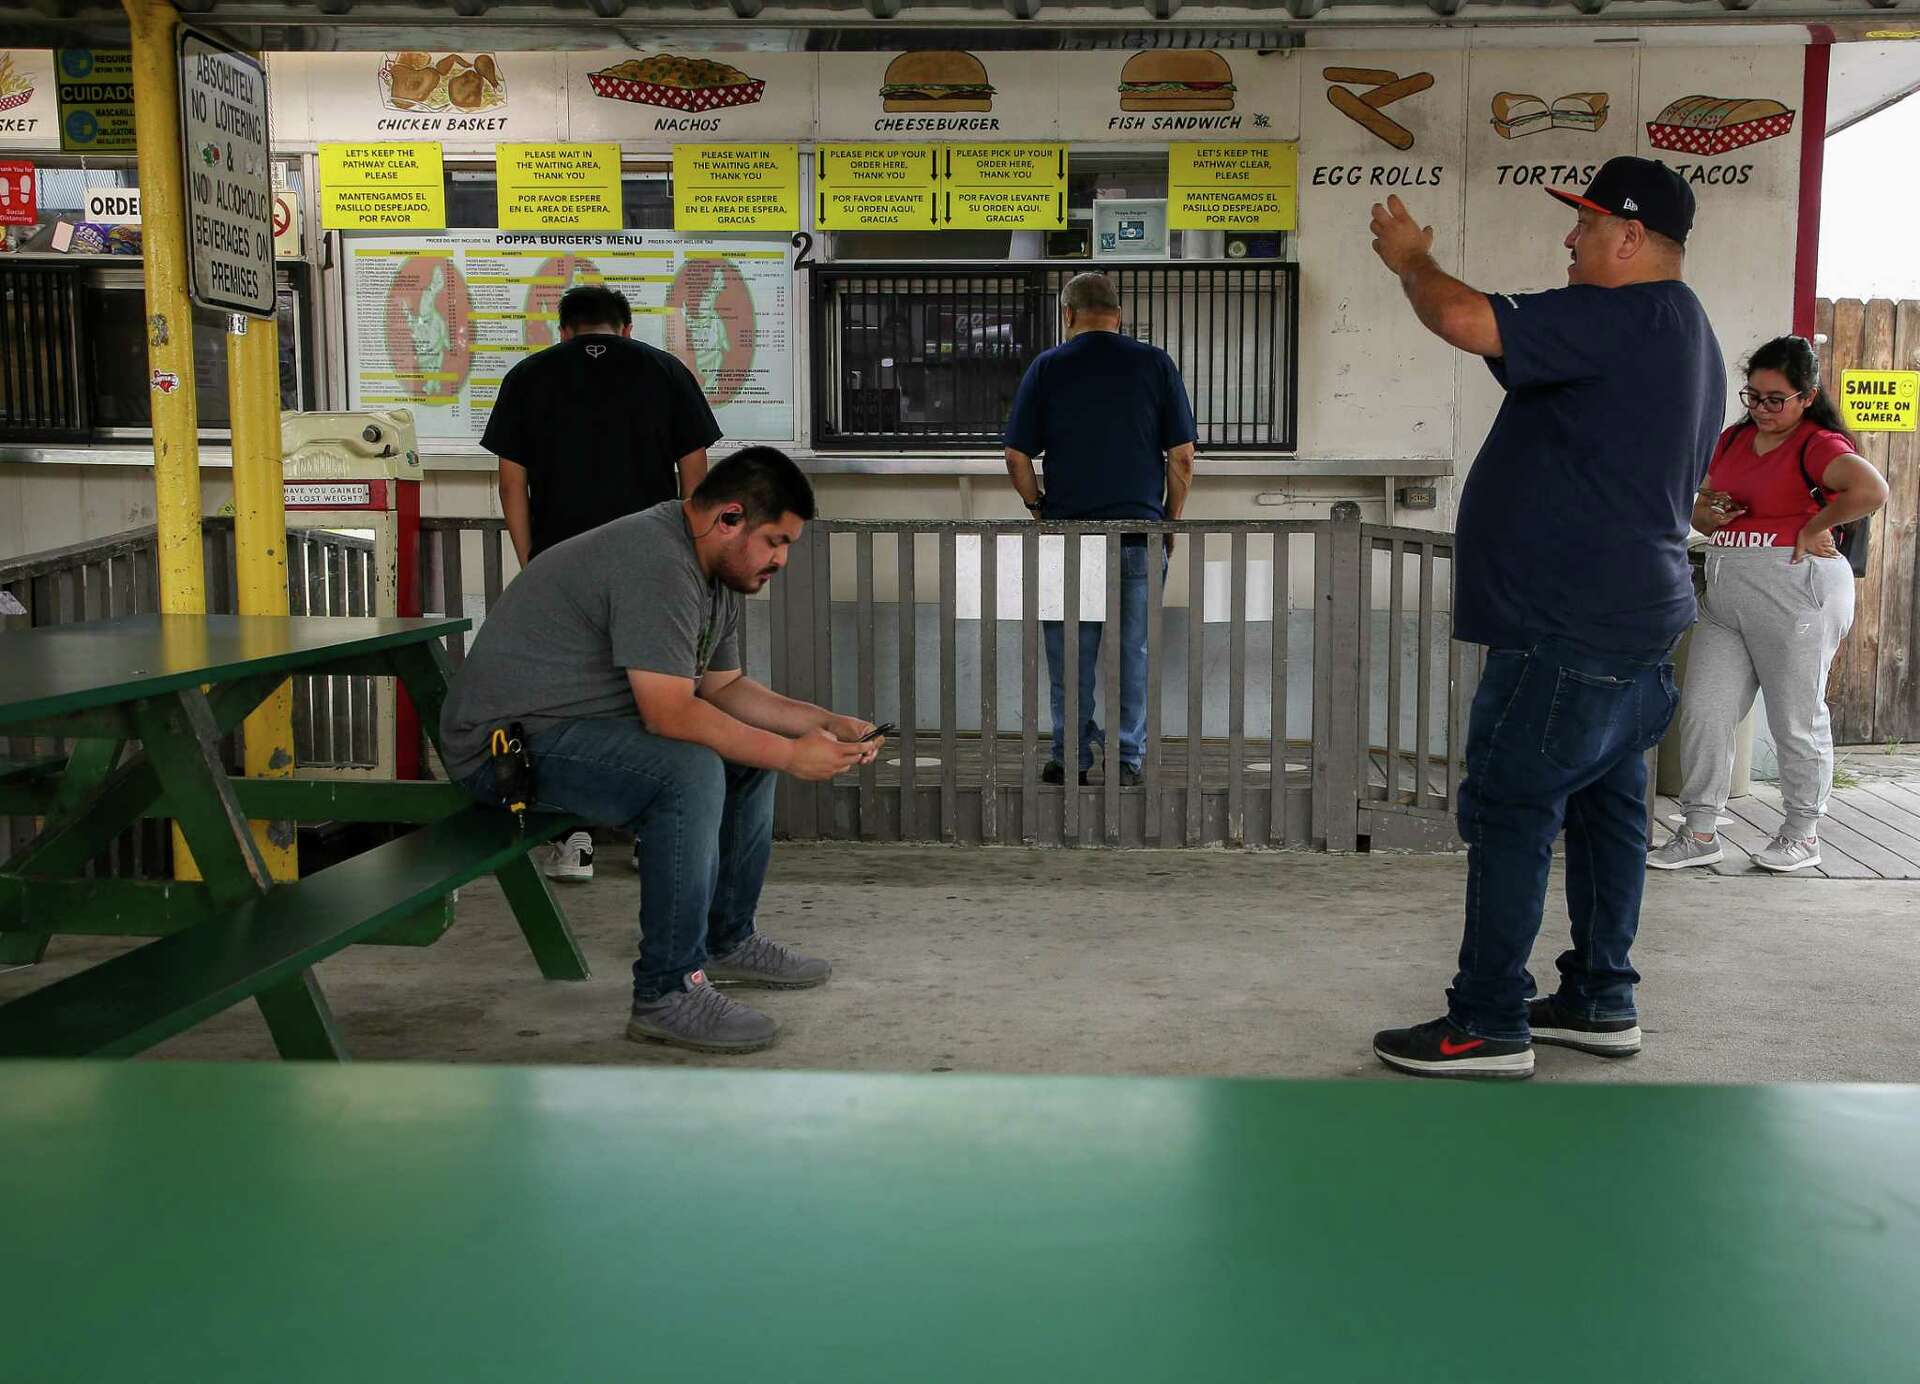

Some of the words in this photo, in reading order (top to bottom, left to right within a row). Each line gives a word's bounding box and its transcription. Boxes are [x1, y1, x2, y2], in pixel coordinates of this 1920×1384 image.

[197, 53, 254, 105] ABSOLUTELY
[191, 88, 207, 123] NO
[214, 98, 262, 145] LOITERING
[376, 117, 442, 131] CHICKEN
[446, 117, 508, 131] BASKET
[654, 117, 721, 132] NACHOS
[874, 116, 1000, 132] CHEESEBURGER
[1108, 115, 1145, 131] FISH
[1151, 115, 1242, 130] SANDWICH
[226, 142, 234, 172] &
[701, 151, 734, 159] PLEASE
[736, 151, 758, 159] WAIT
[760, 151, 769, 159] IN
[830, 150, 864, 158] PLEASE
[865, 150, 886, 158] PICK
[887, 150, 899, 158] UP
[901, 150, 926, 158] YOUR
[1197, 149, 1221, 157] LET'S
[1224, 149, 1248, 157] KEEP
[1251, 149, 1269, 157] THE
[342, 161, 385, 169] PATHWAY
[387, 161, 419, 169] CLEAR,
[850, 161, 881, 169] ORDER
[883, 161, 908, 169] HERE,
[976, 160, 1007, 168] ORDER
[1009, 160, 1034, 168] HERE,
[1193, 160, 1237, 169] PATHWAY
[1240, 160, 1271, 169] CLEAR,
[365, 172, 398, 180] PLEASE
[710, 172, 741, 180] THANK
[743, 172, 762, 180] YOU
[1312, 166, 1362, 186] EGG
[1369, 165, 1443, 186] ROLLS
[1496, 164, 1596, 186] TORTAS
[1674, 164, 1753, 185] TACOS
[193, 171, 209, 205] NO
[216, 180, 267, 223] ALCOHOLIC
[339, 193, 413, 201] MANTENGAMOS
[416, 193, 426, 201] EL
[694, 195, 712, 203] POR
[715, 195, 744, 203] FAVOR
[746, 195, 777, 203] ESPERE
[1187, 193, 1264, 201] MANTENGAMOS
[1266, 193, 1277, 201] EL
[90, 197, 140, 215] ORDE
[335, 204, 372, 212] PASILLO
[374, 204, 430, 212] DESPEJADO,
[843, 205, 854, 213] SU
[857, 205, 889, 213] ORDEN
[891, 205, 915, 213] AQUI,
[968, 204, 980, 212] SU
[982, 204, 1014, 212] ORDEN
[1016, 204, 1041, 212] AQUI,
[1182, 204, 1220, 213] PASILLO
[1222, 204, 1280, 213] DESPEJADO,
[359, 215, 378, 223] POR
[380, 215, 411, 223] FAVOR
[1206, 215, 1225, 223] POR
[1228, 215, 1260, 223] FAVOR
[196, 214, 250, 258] BEVERAGES
[256, 233, 269, 263] ON
[496, 235, 537, 245] POPPA
[540, 235, 603, 245] BURGER'S
[606, 235, 643, 245] MENU
[792, 232, 815, 271] 2
[211, 260, 259, 300] PREMISES
[1846, 380, 1896, 395] SMILE
[1850, 401, 1889, 410] YOU'RE
[1894, 401, 1910, 411] ON
[1856, 412, 1901, 422] CAMERA
